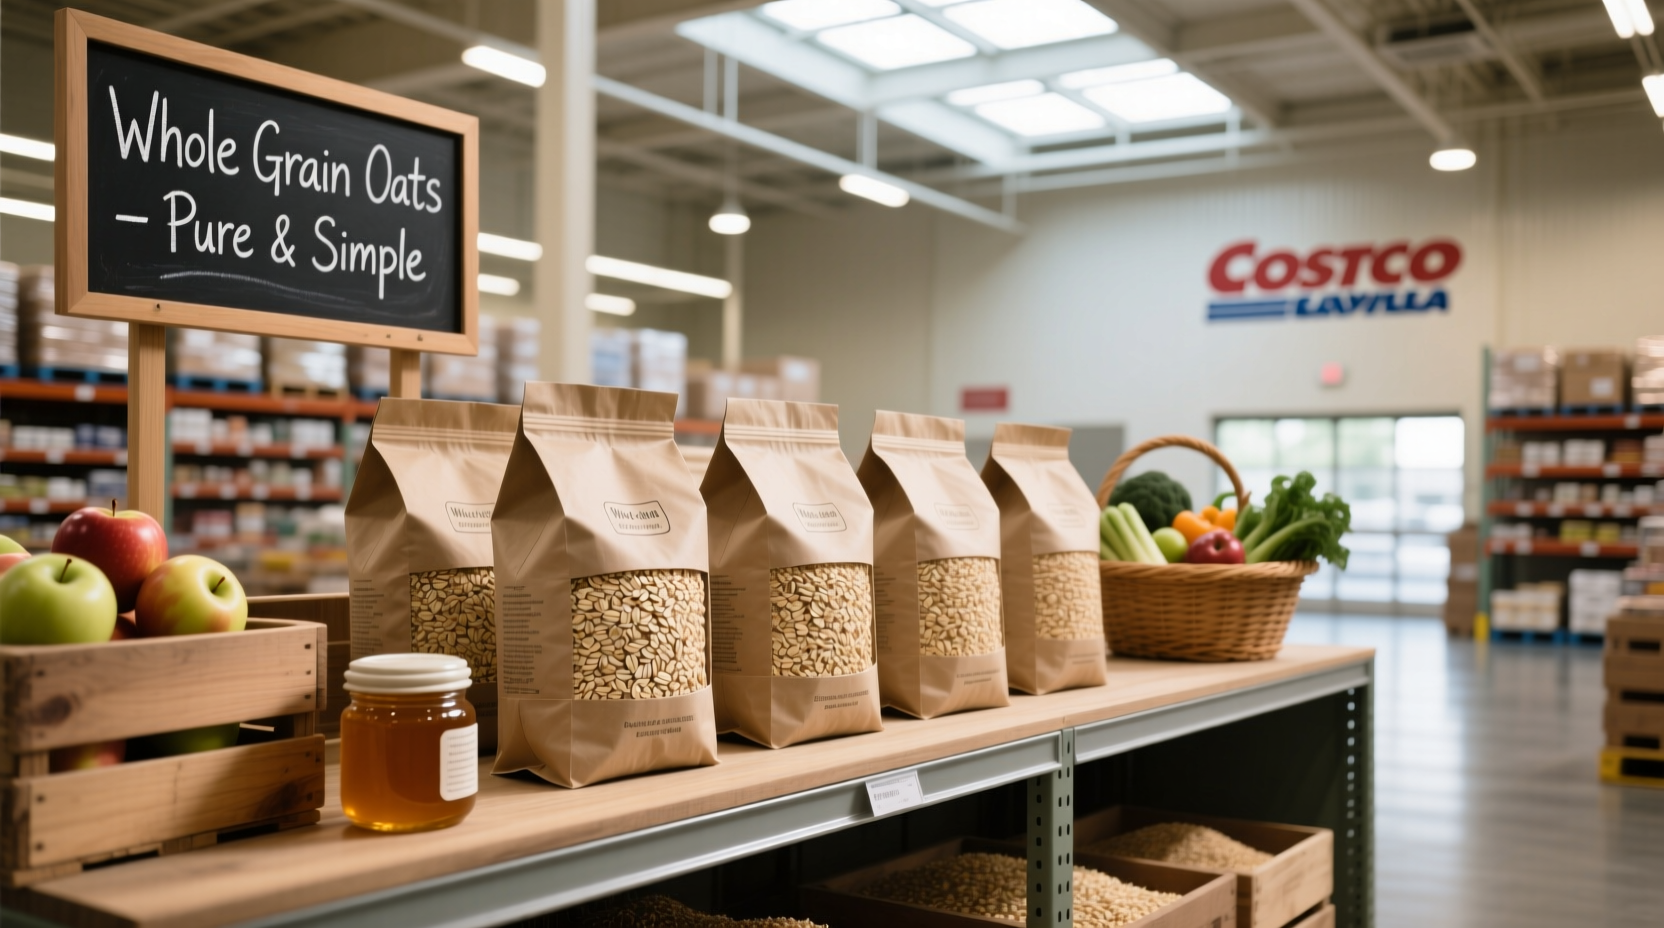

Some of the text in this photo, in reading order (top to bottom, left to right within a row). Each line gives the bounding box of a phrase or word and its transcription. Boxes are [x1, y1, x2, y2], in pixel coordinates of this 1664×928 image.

[109, 86, 443, 214] Whole Grain Oats
[162, 190, 254, 258] Pure
[270, 213, 296, 268] &
[311, 215, 427, 300] Simple
[1208, 240, 1464, 294] COSTCO
